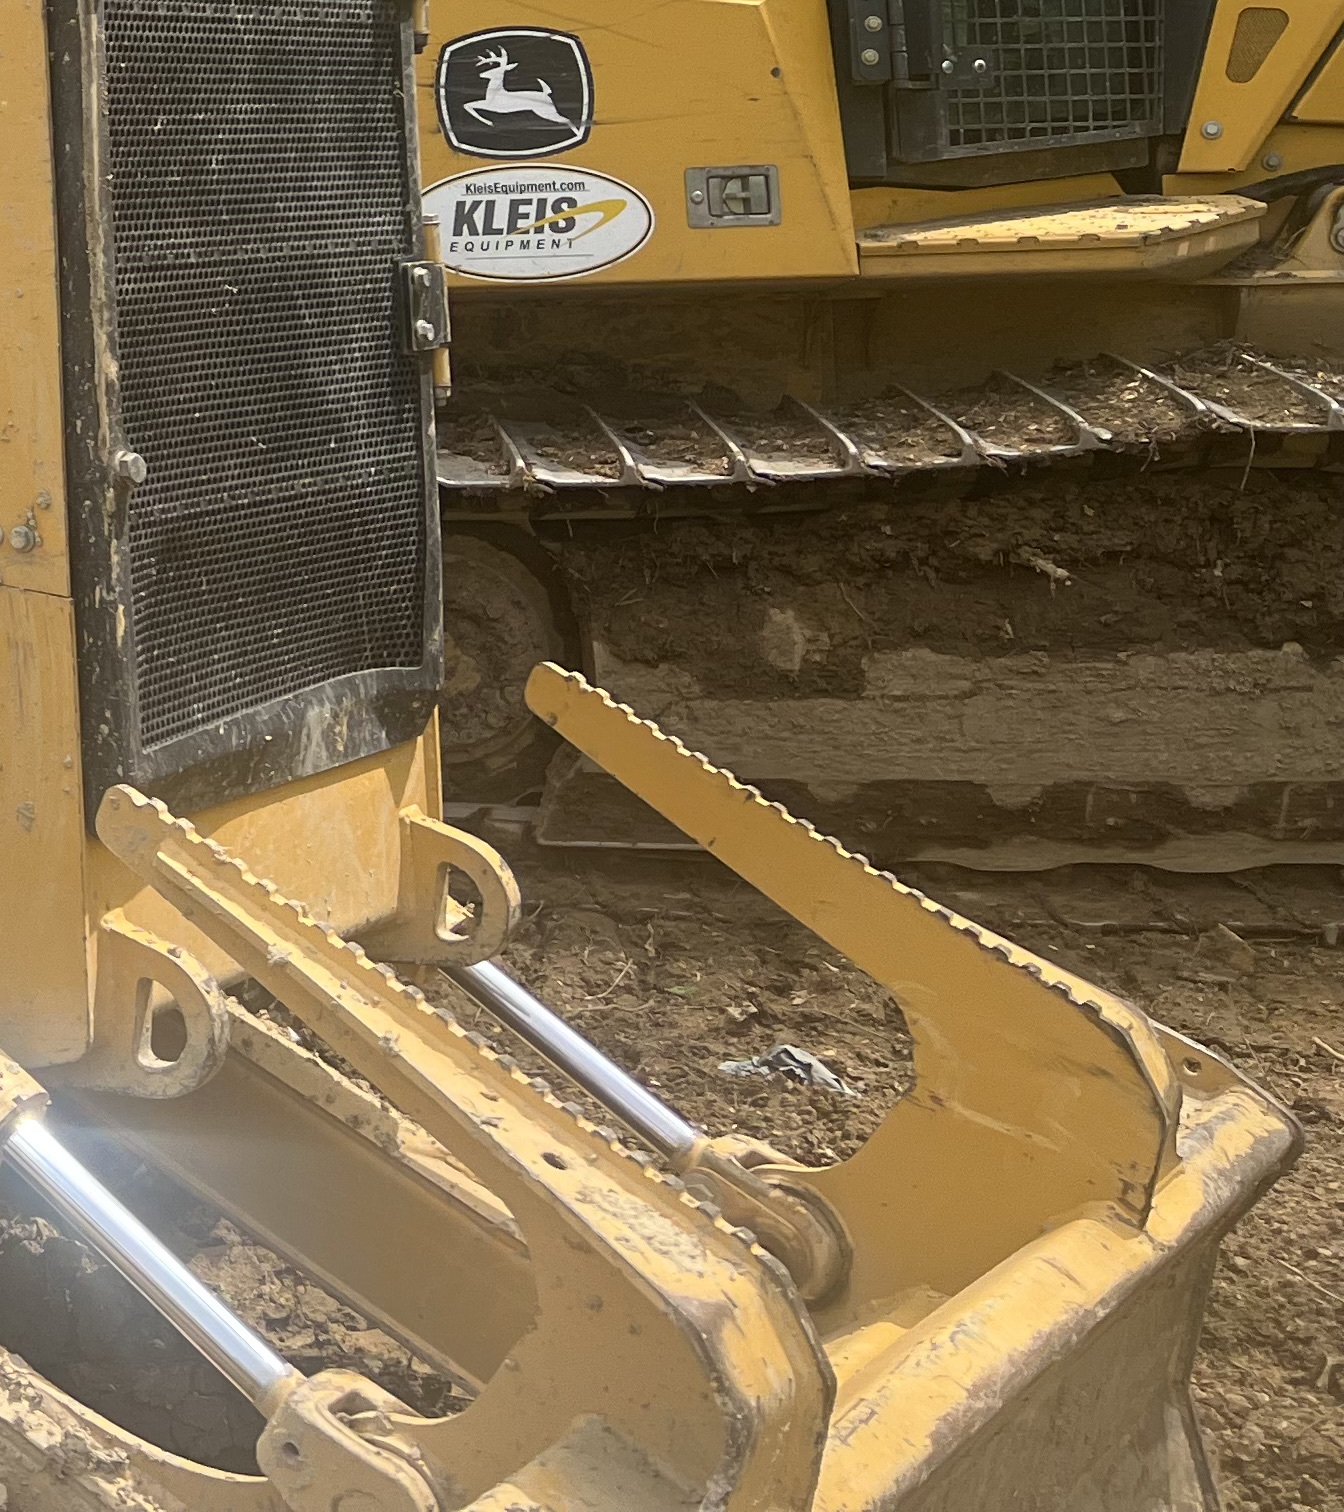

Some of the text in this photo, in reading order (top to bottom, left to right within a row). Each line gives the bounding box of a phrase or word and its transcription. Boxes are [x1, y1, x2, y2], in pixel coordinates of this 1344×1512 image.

[465, 181, 586, 195] KleisEquipment.com
[452, 197, 578, 237] KLEIS
[450, 238, 574, 253] EQUIPMENT
